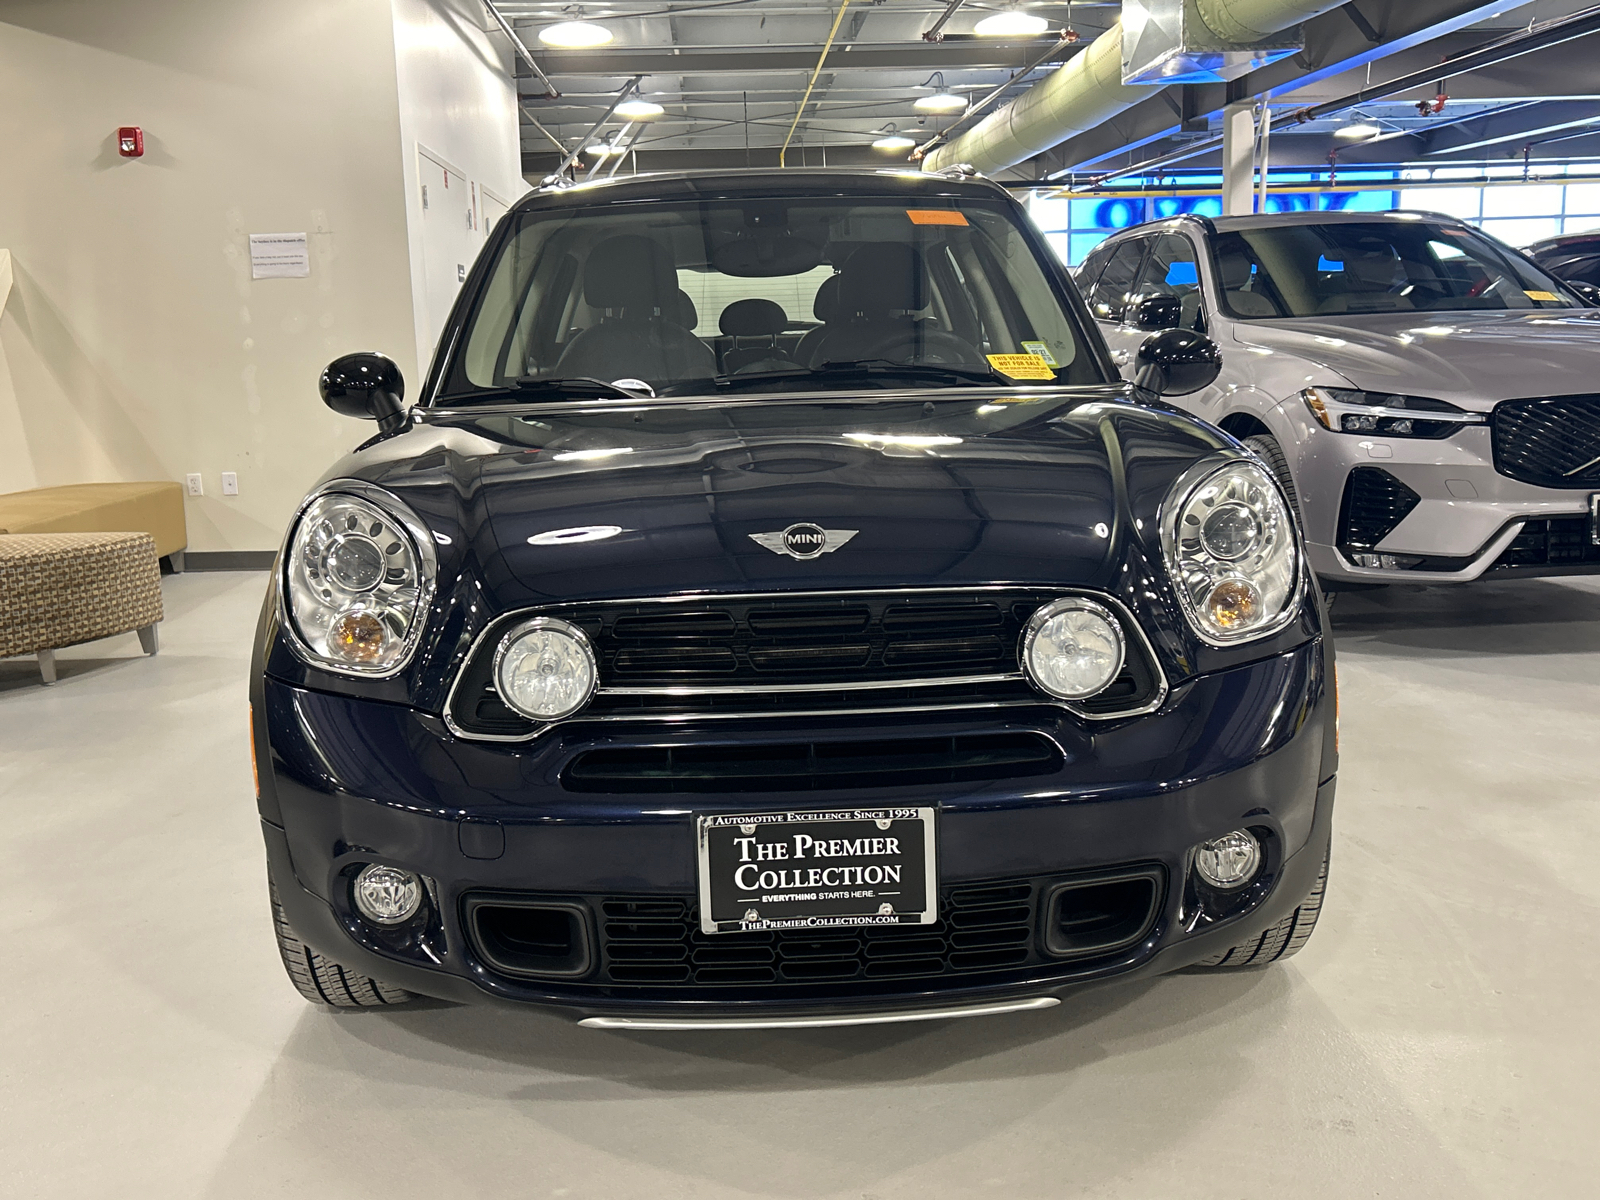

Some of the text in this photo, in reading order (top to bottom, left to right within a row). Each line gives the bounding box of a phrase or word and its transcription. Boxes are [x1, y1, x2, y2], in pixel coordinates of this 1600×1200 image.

[787, 533, 822, 544] MINI
[715, 809, 917, 826] AUTOMOTIVE EXCELLENCE SINCE 1995
[733, 834, 901, 862] THE PREMIER
[734, 864, 902, 890] COLLECTION
[762, 890, 875, 903] EVERYTHING STARTS HERE.
